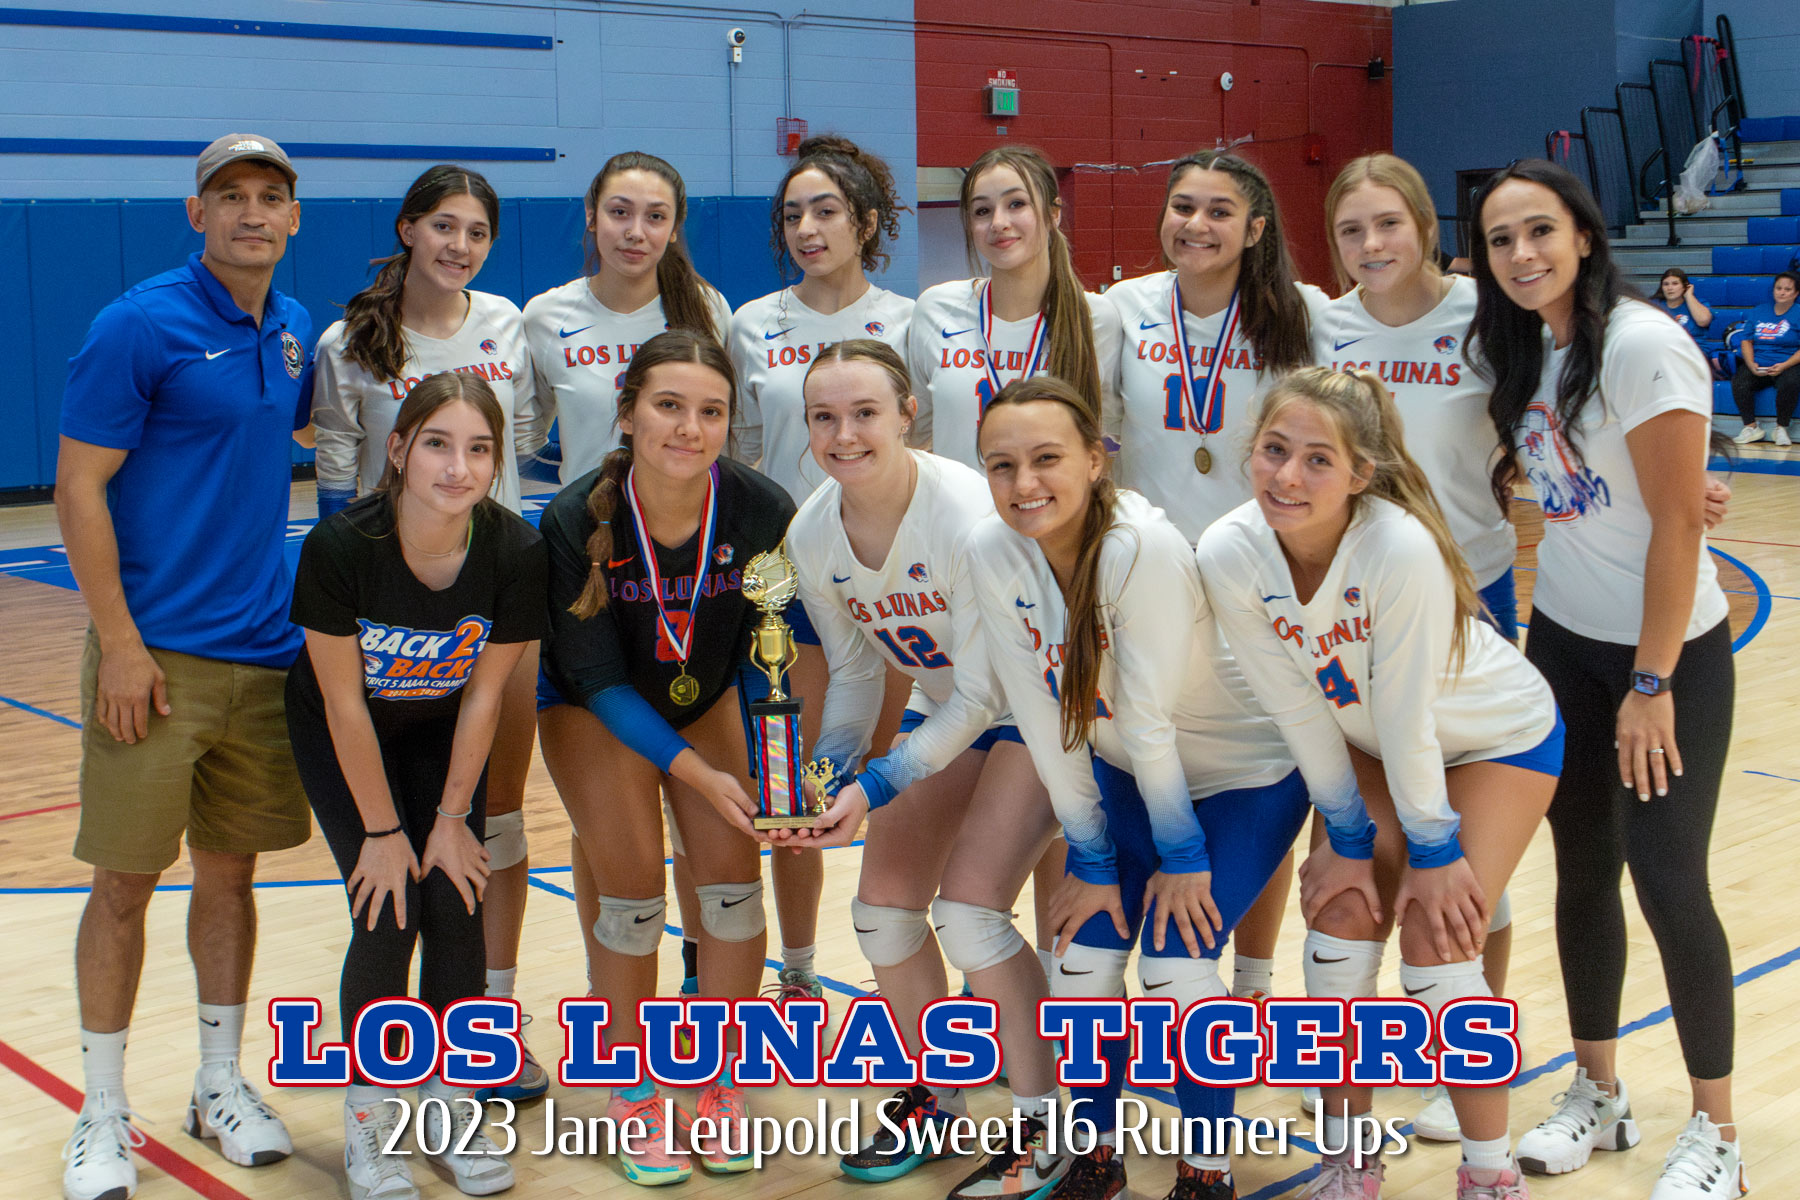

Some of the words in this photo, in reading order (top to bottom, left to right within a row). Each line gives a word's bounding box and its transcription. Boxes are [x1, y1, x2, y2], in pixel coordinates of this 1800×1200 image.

[988, 77, 1016, 88] SMOKING
[997, 70, 1006, 79] NO
[564, 344, 611, 369] LOS
[767, 344, 811, 369] LOS
[940, 347, 985, 369] LOS
[1137, 339, 1181, 365] LOS
[1378, 360, 1461, 386] LUNAS
[1163, 373, 1226, 434] 10
[610, 577, 654, 602] LOS
[660, 568, 742, 600] LUNAS
[873, 590, 947, 620] LUNAS
[360, 625, 453, 659] BACK
[445, 620, 484, 660] 2
[873, 625, 954, 670] 12
[385, 657, 476, 679] BACK
[389, 680, 399, 688] 5
[1315, 655, 1362, 710] 4
